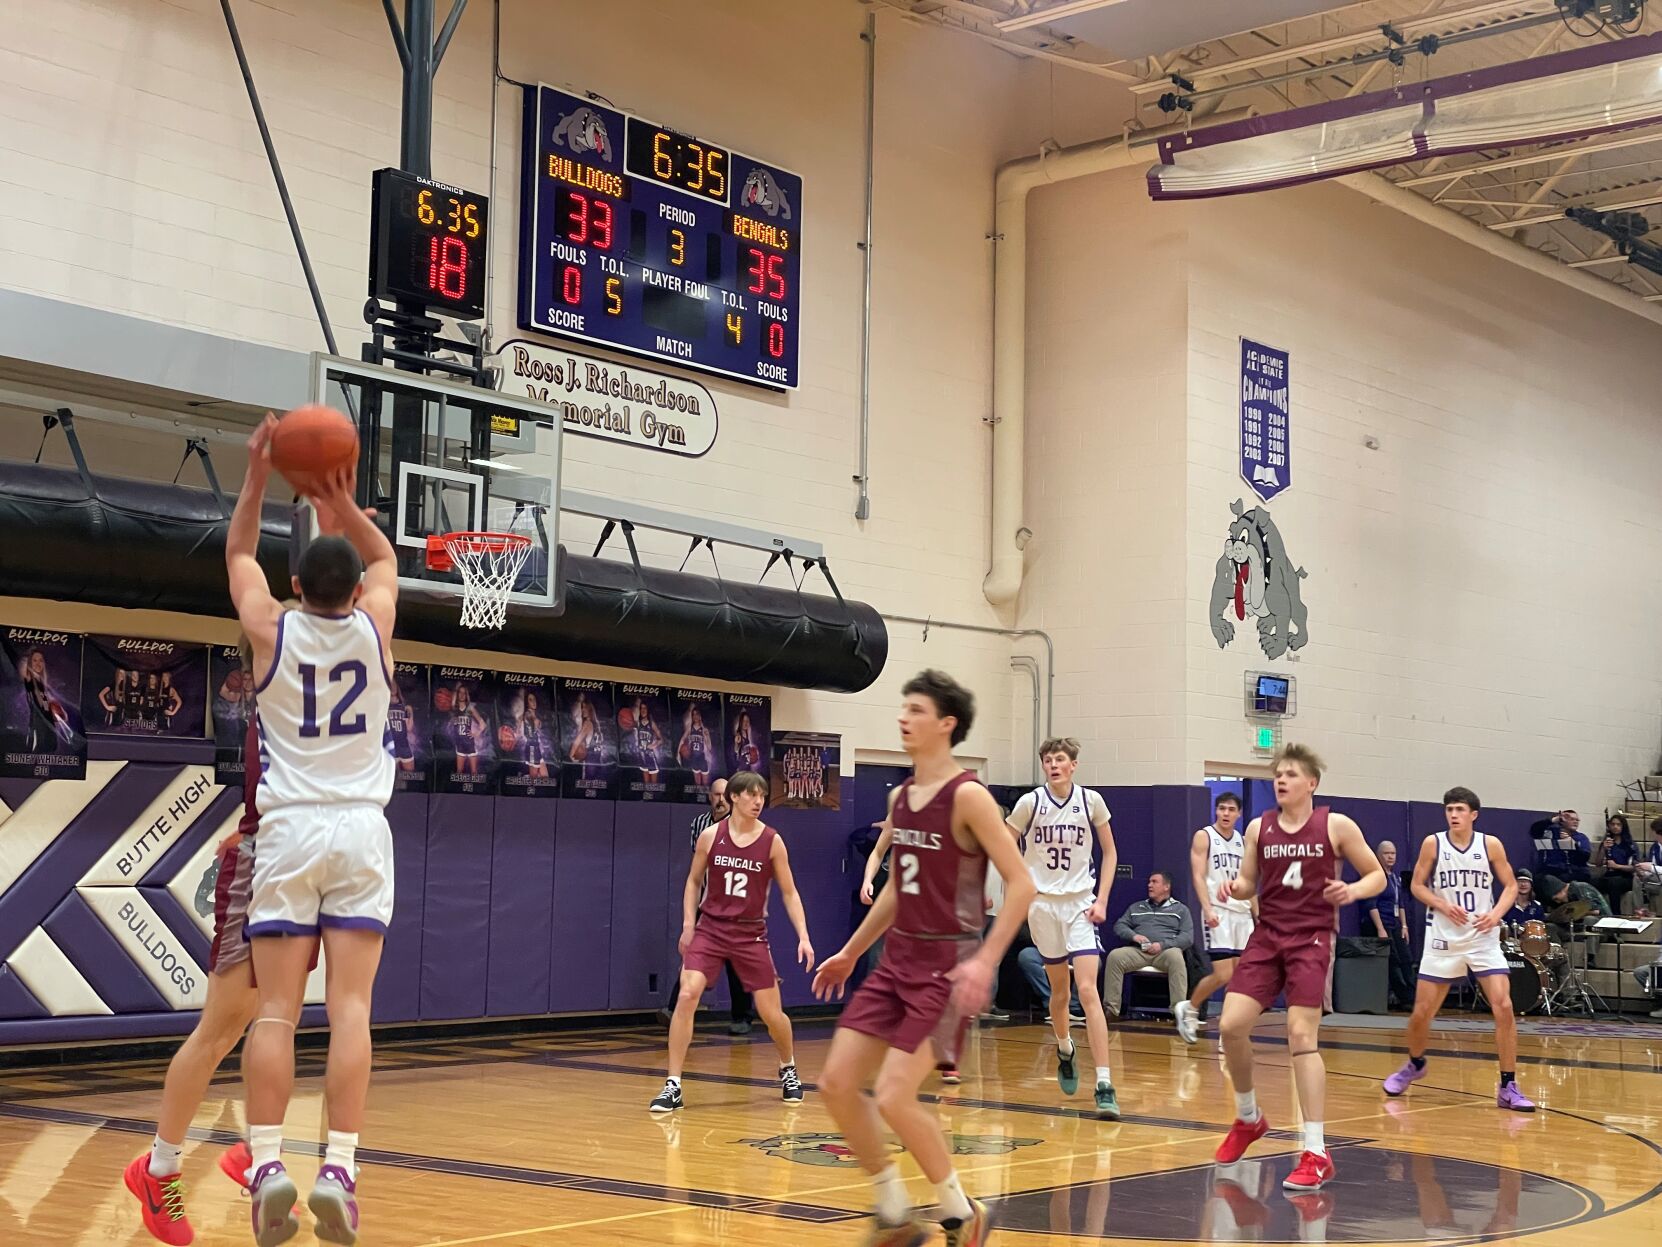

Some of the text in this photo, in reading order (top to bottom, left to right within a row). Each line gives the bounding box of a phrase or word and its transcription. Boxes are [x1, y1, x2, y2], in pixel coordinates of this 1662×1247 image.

[549, 154, 623, 198] BULLDOGS
[654, 132, 725, 196] 6:35
[416, 176, 464, 195] DAKTRONICS
[568, 193, 612, 249] 33
[659, 203, 696, 227] PERIOD
[733, 214, 789, 250] BENGALS
[550, 241, 587, 266] FOULS
[671, 229, 685, 265] 3
[429, 236, 468, 299] 18
[599, 255, 630, 278] T.O.L.
[748, 248, 785, 299] 35
[563, 266, 581, 304] 0
[606, 277, 621, 315] 5
[642, 268, 711, 301] PLAYER FOUL
[721, 291, 748, 312] T.O.L.
[757, 300, 788, 322] FOULS
[548, 307, 585, 332] SCORE
[726, 313, 742, 344] 4
[656, 336, 693, 358] MATCH
[769, 323, 784, 358] 0
[513, 346, 701, 416] Ross J. Richardson
[756, 361, 788, 382] SCORE
[1262, 364, 1284, 380] STATE
[526, 384, 632, 436] Mmorial
[639, 410, 686, 447] Gym
[8, 628, 69, 646] BULLDOG
[117, 639, 174, 655] BULLDOG
[440, 667, 484, 681] BULLDOG
[504, 673, 545, 687] BULLDOG
[564, 679, 604, 692] BULLDOG
[298, 660, 368, 738] 12
[622, 684, 660, 697] BULLDOG
[677, 689, 713, 702] BULLDOG
[729, 694, 764, 707] BULLDOG
[115, 773, 212, 877] BUTTE HIGH
[1034, 824, 1086, 847] BUTTE
[1046, 847, 1072, 872] 35
[1263, 843, 1325, 859] BENGALS
[714, 855, 763, 873] BENGALS
[899, 853, 920, 896] 2
[1281, 861, 1304, 890] 4
[723, 870, 749, 899] 12
[1439, 869, 1490, 890] BUTTE
[1455, 890, 1476, 913] 10
[117, 901, 196, 996] BULLDOGS
